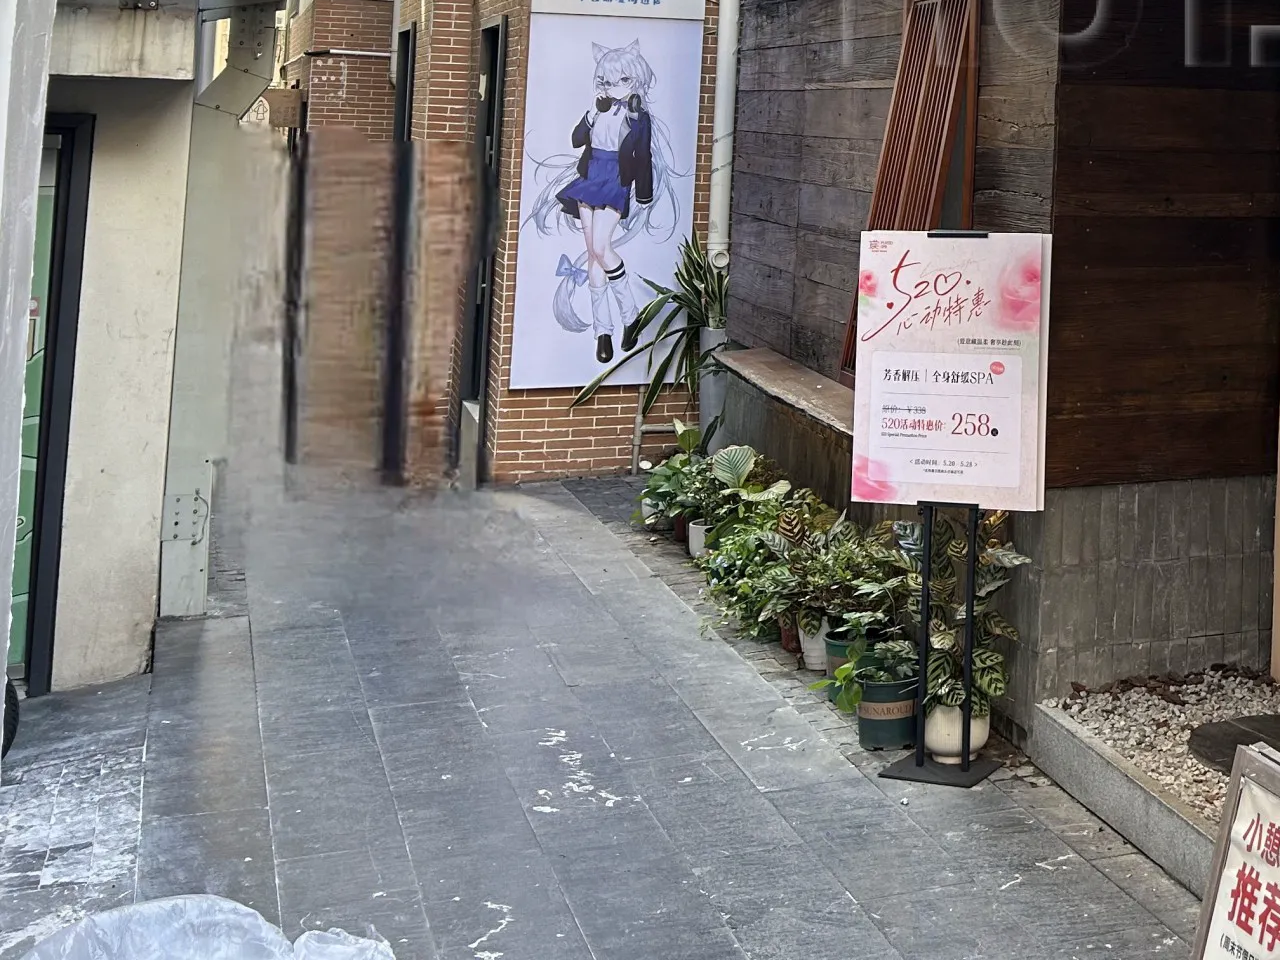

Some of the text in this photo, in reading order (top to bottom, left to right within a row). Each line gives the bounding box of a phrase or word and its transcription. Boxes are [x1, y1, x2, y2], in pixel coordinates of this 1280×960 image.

[883, 368, 920, 382] 芳香解压
[951, 412, 990, 437] 258
